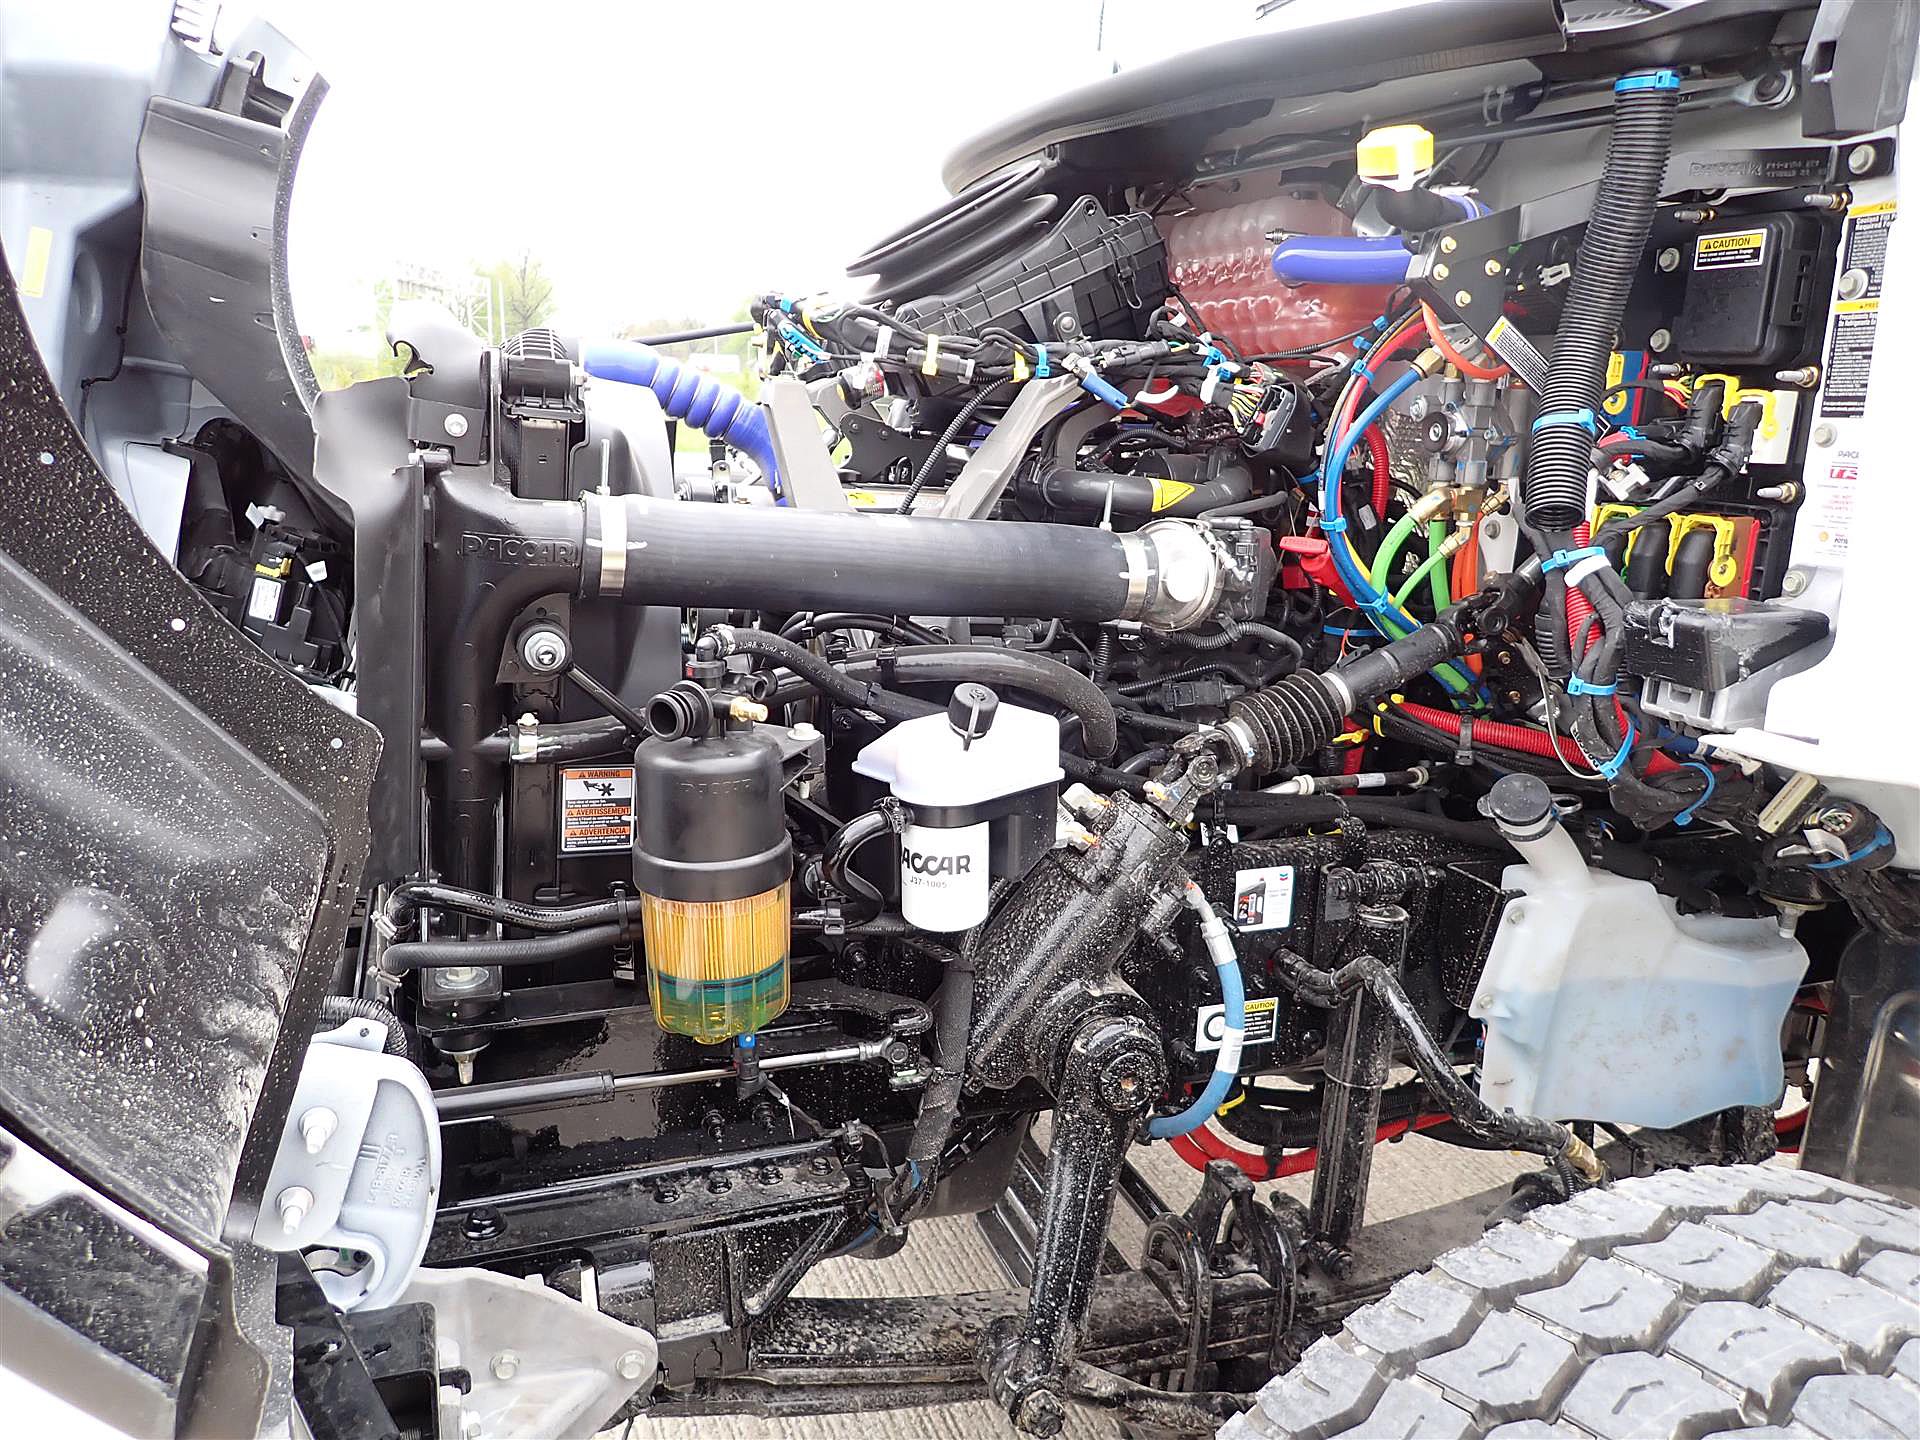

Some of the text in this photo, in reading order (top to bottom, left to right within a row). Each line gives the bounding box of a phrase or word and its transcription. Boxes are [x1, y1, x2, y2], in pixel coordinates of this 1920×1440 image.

[1712, 237, 1751, 249] CAUTION
[461, 532, 579, 563] PACCAR
[587, 770, 621, 778] WARNING
[576, 807, 630, 817] AVERTISSEMENT
[579, 827, 627, 837] ADVERTENCIA
[1244, 1001, 1276, 1011] CAUTION
